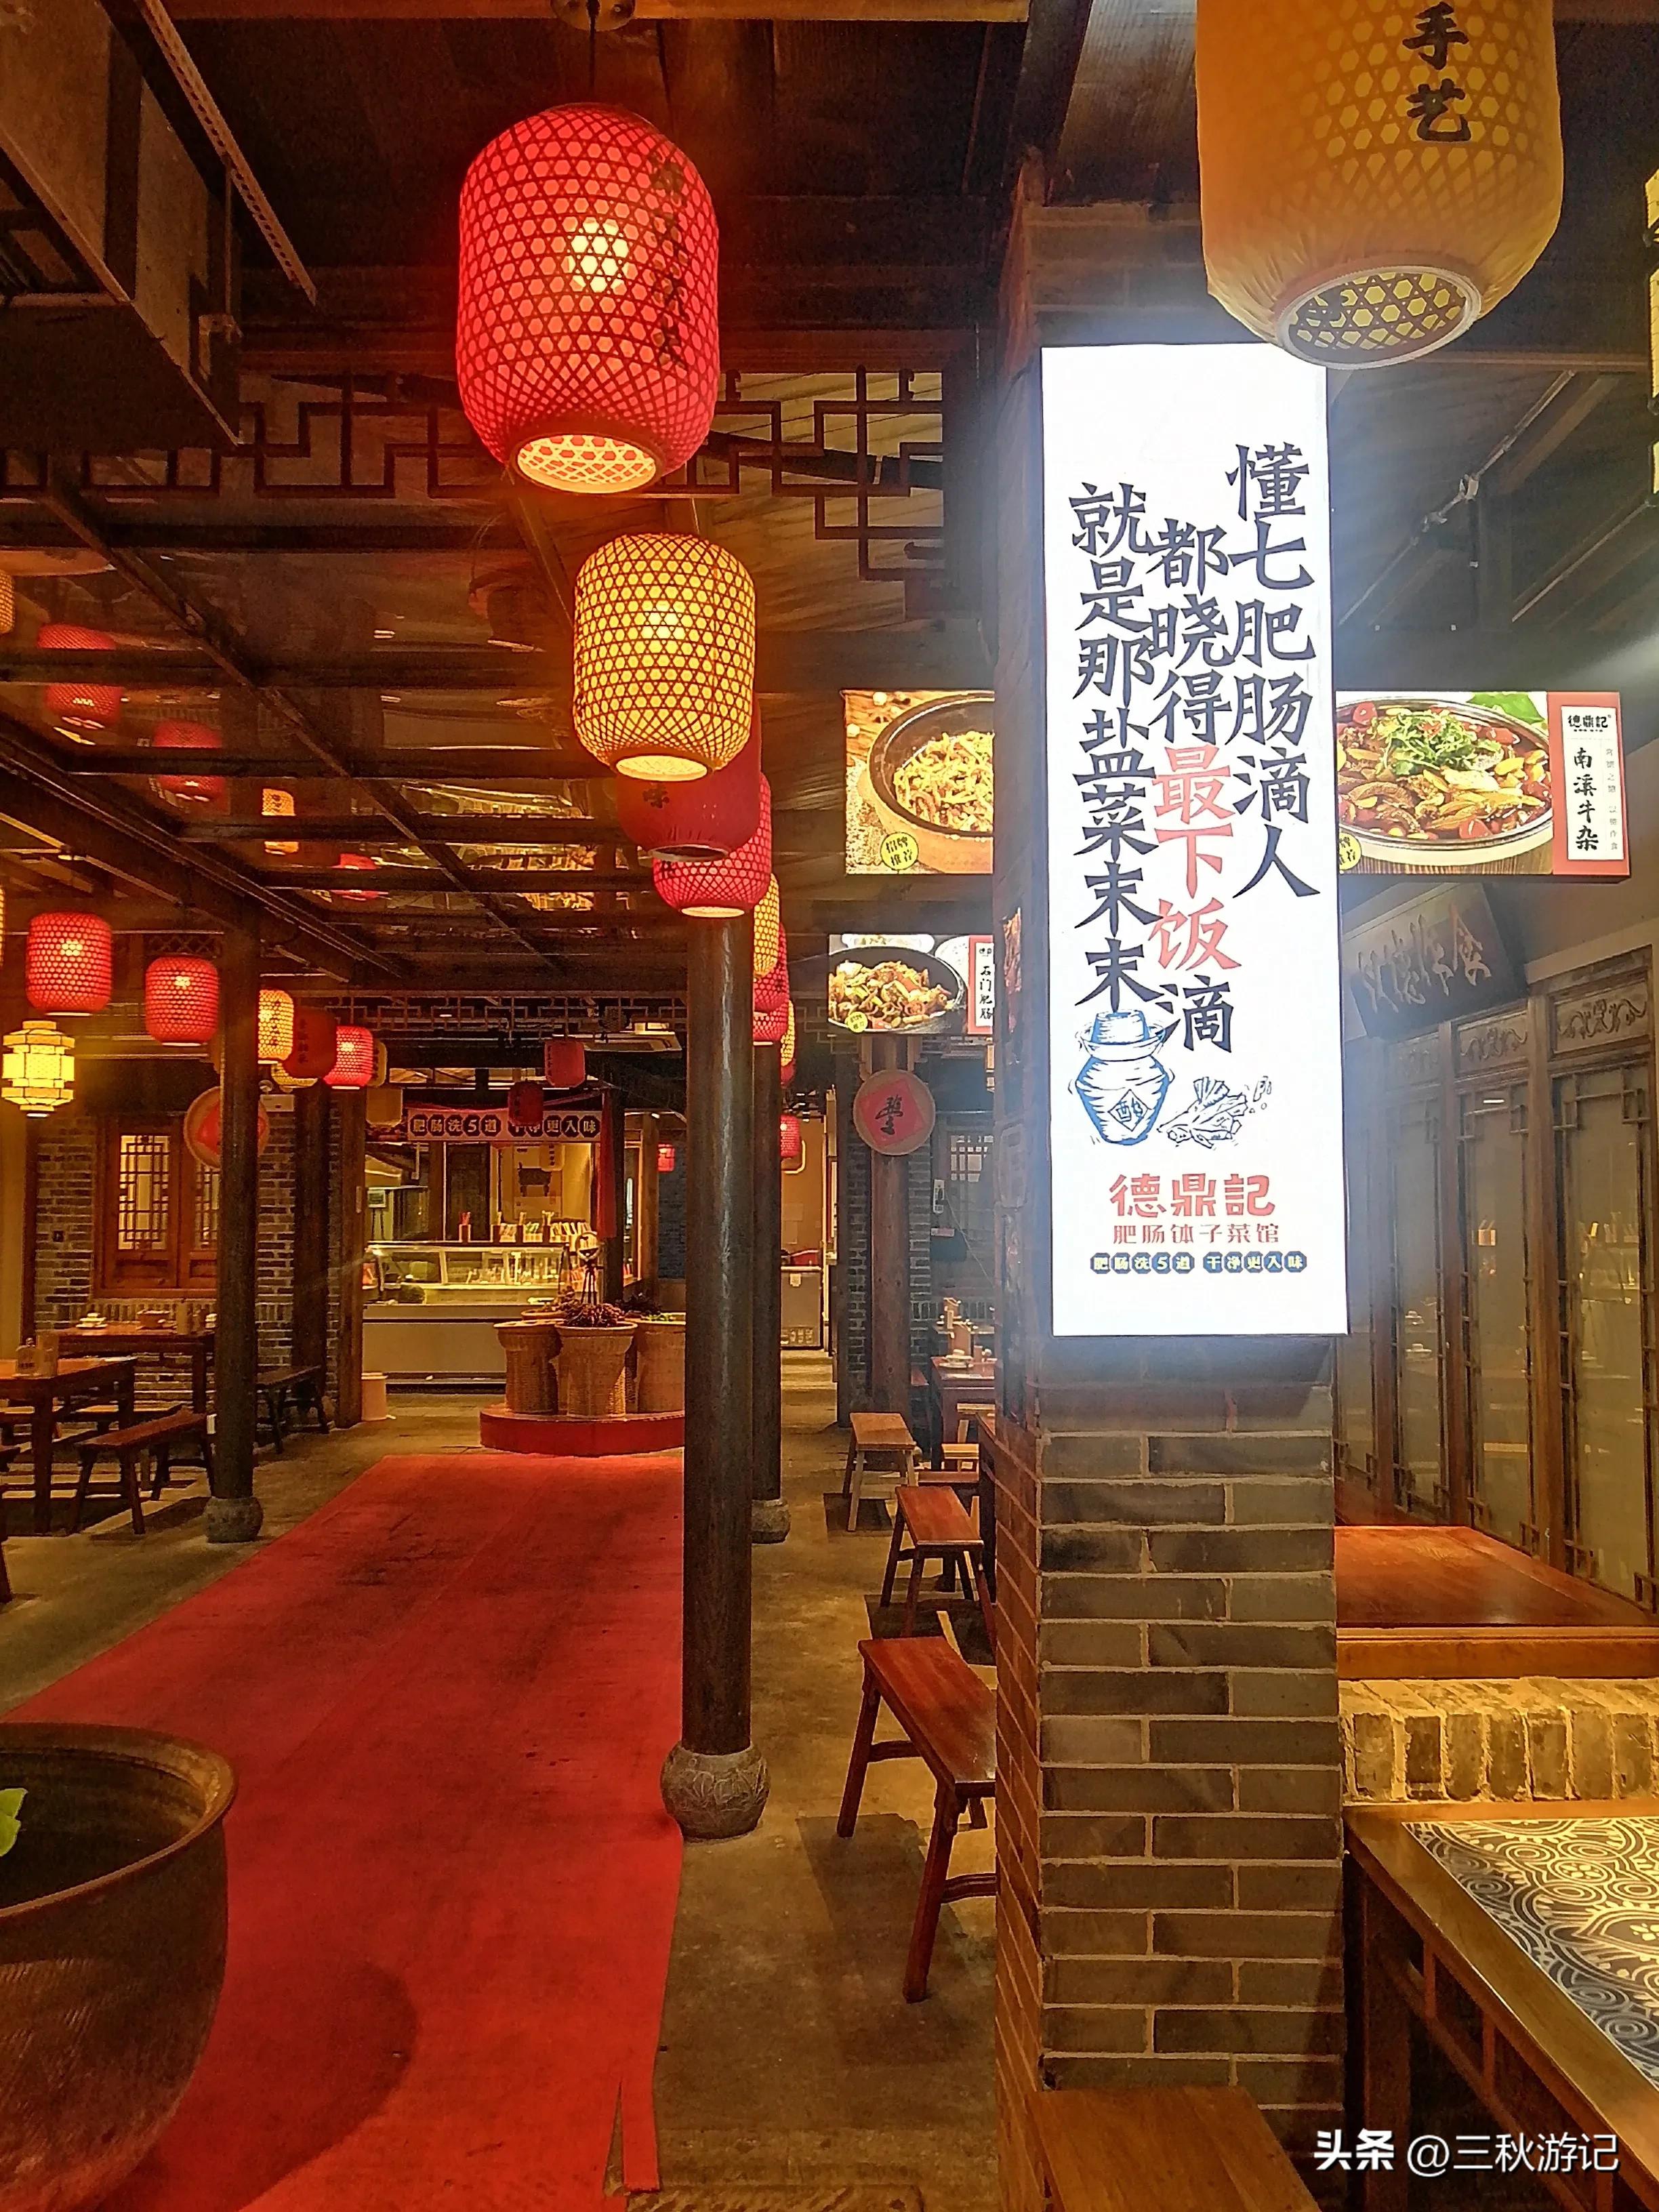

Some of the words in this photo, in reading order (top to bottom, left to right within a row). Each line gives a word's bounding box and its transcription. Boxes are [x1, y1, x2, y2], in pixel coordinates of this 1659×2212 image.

[1403, 1, 1472, 142] 手艺
[1225, 442, 1320, 899] 懂七肥肠滴人
[1069, 482, 1164, 1013] 就是那盐菜末末
[1146, 518, 1242, 1052] 都晓得最下饭滴
[1573, 747, 1599, 851] 南溪牛杂
[412, 1118, 497, 1133] 肥肠洗5道
[1109, 1173, 1275, 1218] 德鼎記
[1113, 1223, 1279, 1244] 肥肠钵子菜馆
[1092, 1253, 1193, 1273] 肥肠洗5道
[1205, 1252, 1305, 1272] 干净更入味
